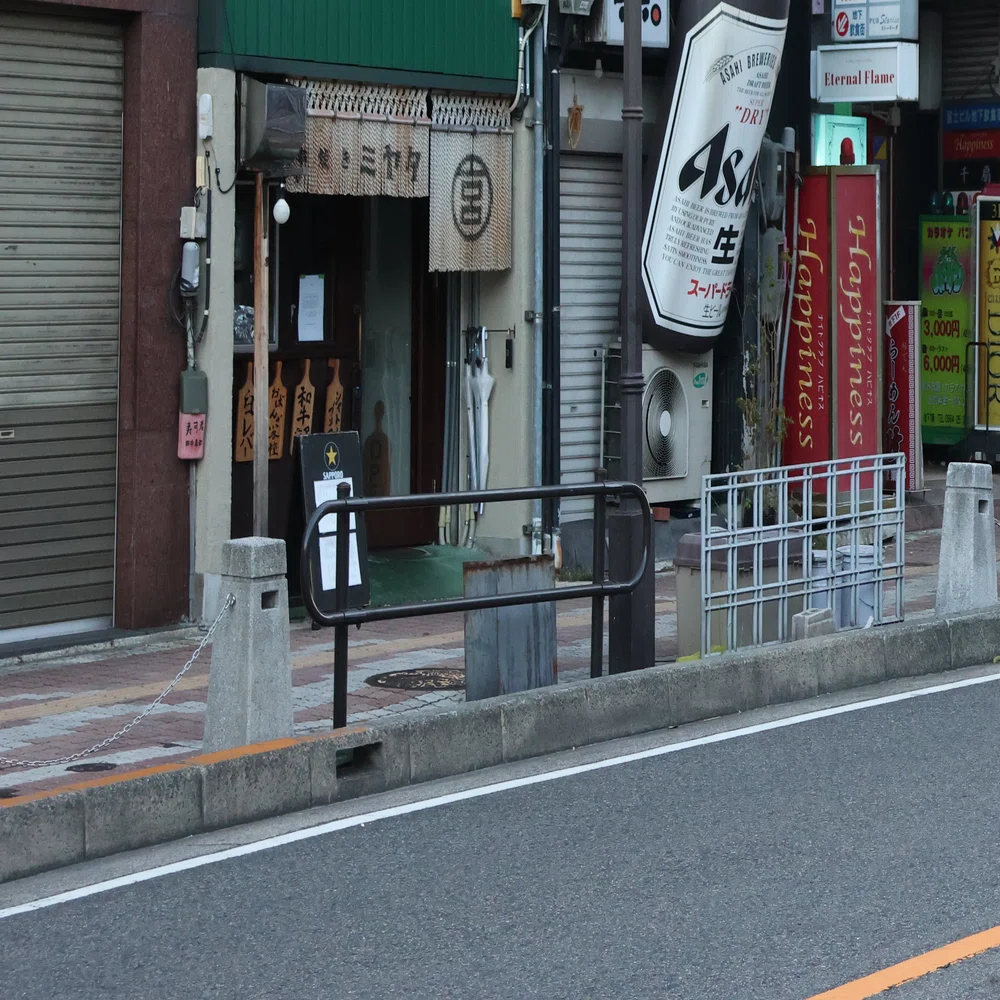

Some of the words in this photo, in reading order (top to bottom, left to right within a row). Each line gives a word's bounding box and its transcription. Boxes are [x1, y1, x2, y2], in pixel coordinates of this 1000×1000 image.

[719, 59, 744, 86] ASAHI
[824, 70, 862, 87] Eternal
[864, 69, 895, 85] Flame
[711, 224, 740, 265] 生
[791, 217, 824, 449] Happiness
[839, 214, 873, 446] Happiness
[923, 319, 961, 338] 3,000円
[923, 355, 960, 375] 6,000円
[322, 470, 344, 480] SAPPORO
